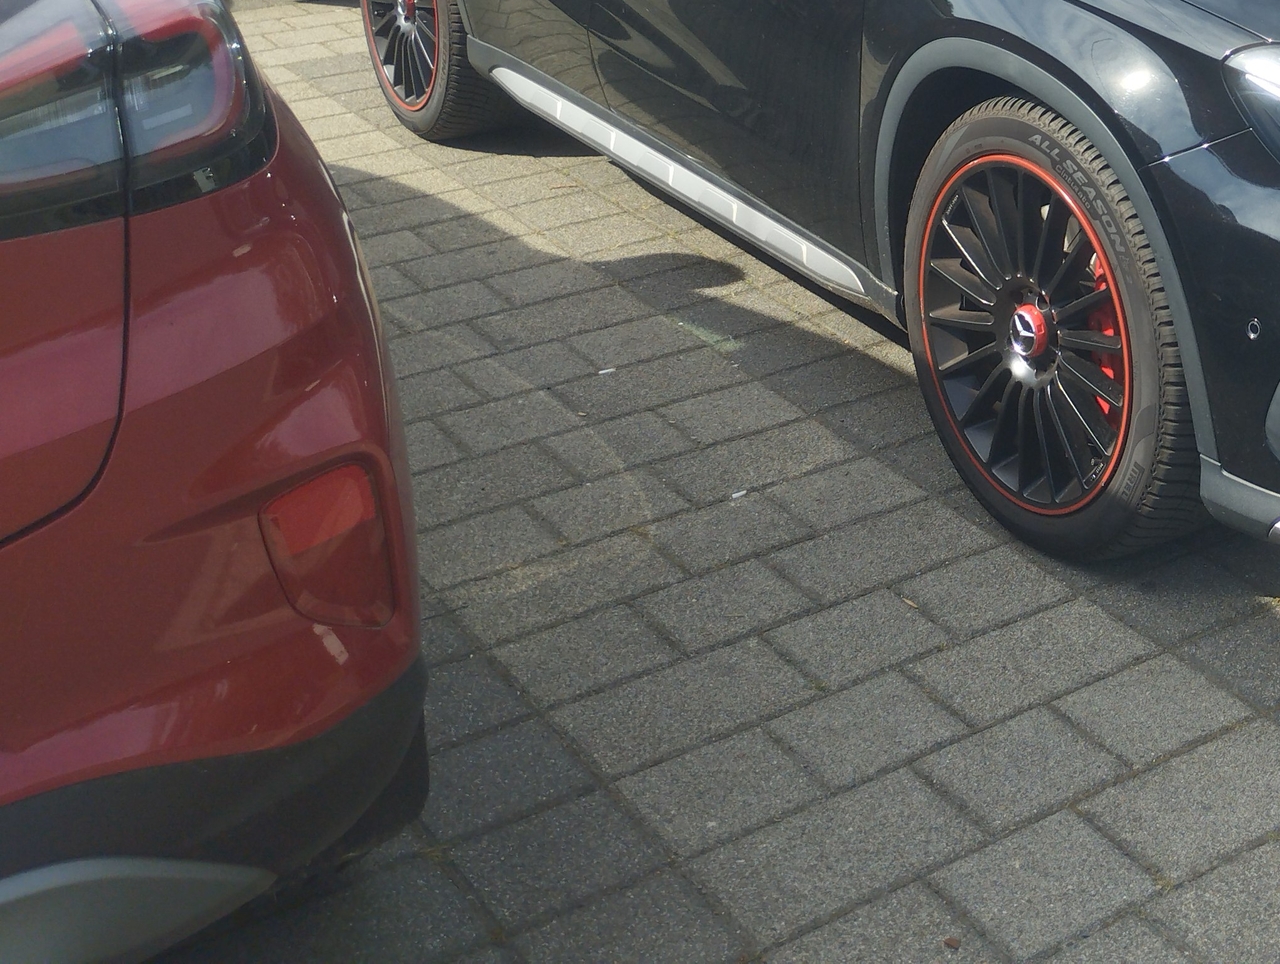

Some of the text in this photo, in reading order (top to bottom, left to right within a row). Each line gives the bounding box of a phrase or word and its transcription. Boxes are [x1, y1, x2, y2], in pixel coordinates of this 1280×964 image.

[1028, 134, 1126, 253] ALL SEASON
[1055, 164, 1091, 209] Cinturato
